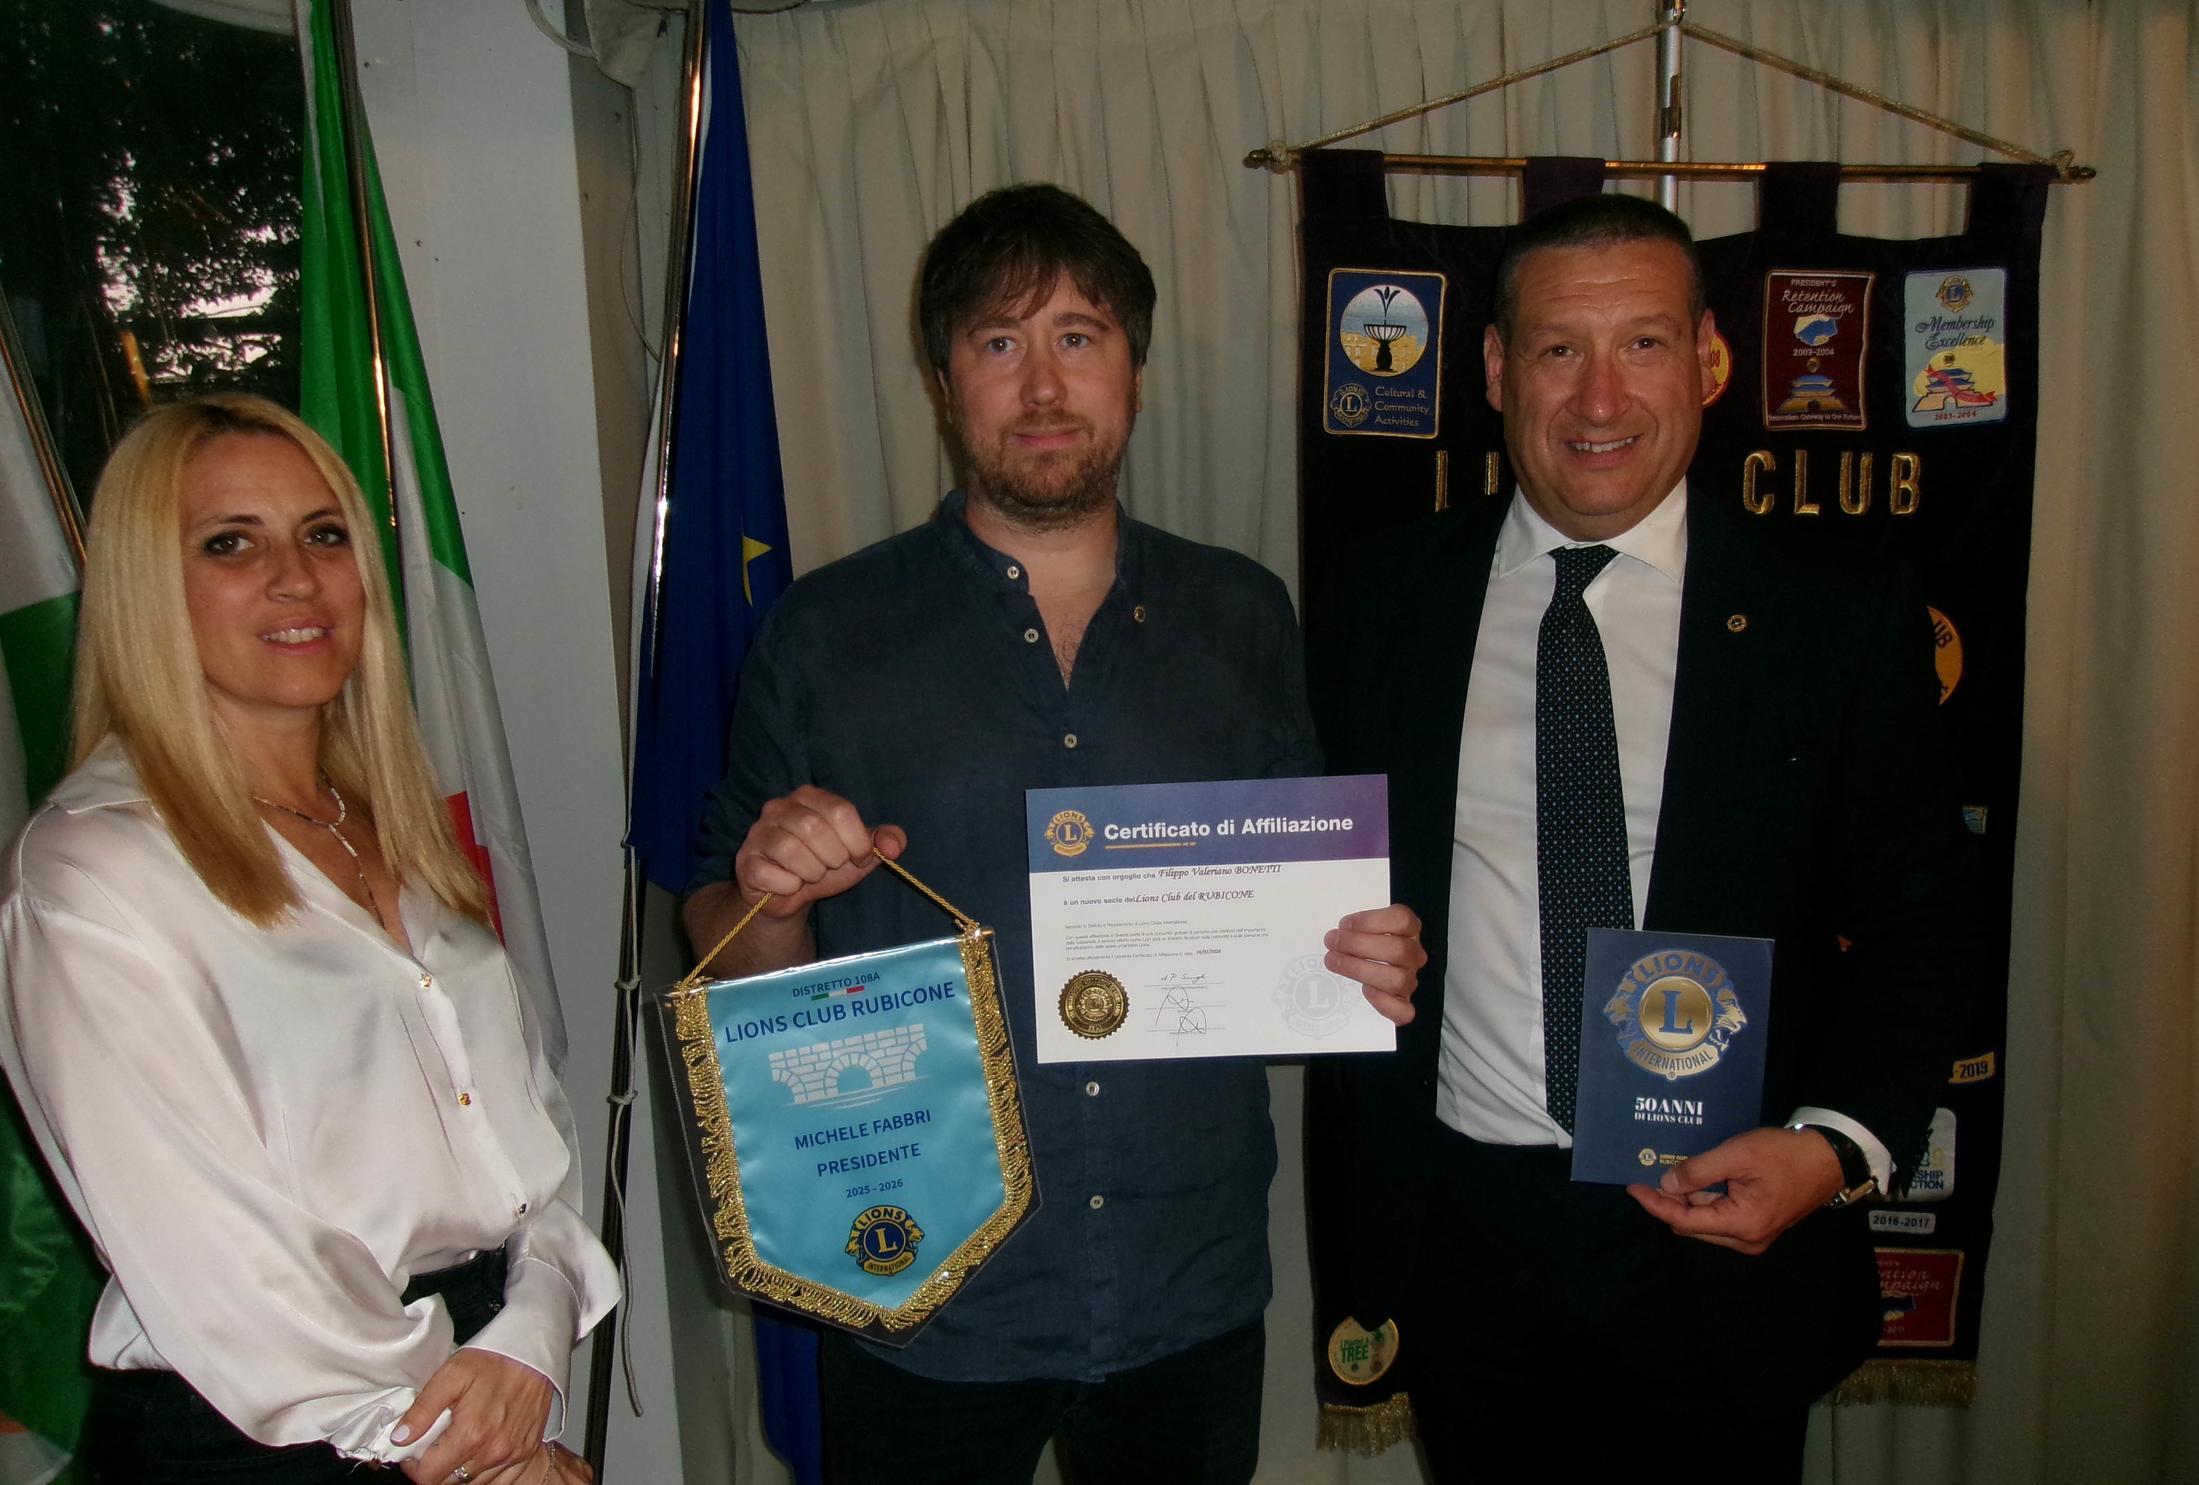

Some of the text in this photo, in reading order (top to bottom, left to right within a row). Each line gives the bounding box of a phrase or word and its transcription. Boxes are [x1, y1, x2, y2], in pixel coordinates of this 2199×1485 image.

[1782, 289, 1845, 303] Retention
[1788, 301, 1855, 317] Campaign
[1915, 315, 1995, 334] Membership
[1925, 333, 1986, 351] Excellence
[1793, 348, 1835, 357] 2003-2004
[1375, 386, 1427, 398] Cultural &
[1345, 397, 1357, 412] L
[1375, 401, 1430, 415] Community
[1375, 415, 1420, 426] Activities
[1742, 449, 1921, 516] CLUB
[1935, 620, 1953, 648] UB
[1055, 811, 1083, 822] LIONS
[1065, 824, 1077, 841] L
[1104, 816, 1353, 840] Certificato di Affiliazione
[1112, 873, 1141, 881] orgoglio
[1158, 868, 1189, 879] Filippo
[1191, 866, 1232, 876] Valeriano
[1234, 864, 1281, 874] BONETTI
[1135, 894, 1159, 902] Lions
[1161, 891, 1181, 902] Club
[1183, 890, 1195, 901] del
[1198, 889, 1255, 901] RUBICONE
[1637, 952, 1723, 983] LIONS
[793, 972, 880, 997] DISTRETTO 108A
[725, 981, 956, 1042] LIONS CLUB RUBICONE
[1658, 990, 1693, 1034] L
[1636, 1046, 1714, 1071] INTERNATIONAL
[1955, 1061, 1988, 1078] -2019
[1647, 1113, 1676, 1123] LIONS
[1677, 1115, 1703, 1125] CLUB
[795, 1109, 931, 1150] MICHELE FABBRI
[817, 1143, 921, 1177] PRESIDENTE
[1915, 1170, 1944, 1181] SHIP
[845, 1185, 871, 1198] 2025
[879, 1178, 904, 1192] 2026
[1911, 1180, 1944, 1190] CTION
[858, 1207, 904, 1227] LIONS
[1873, 1215, 1930, 1228] 2016-2017
[874, 1227, 898, 1253] L
[866, 1255, 912, 1272] INTERNATIONAL
[1342, 1344, 1369, 1363] TREE
